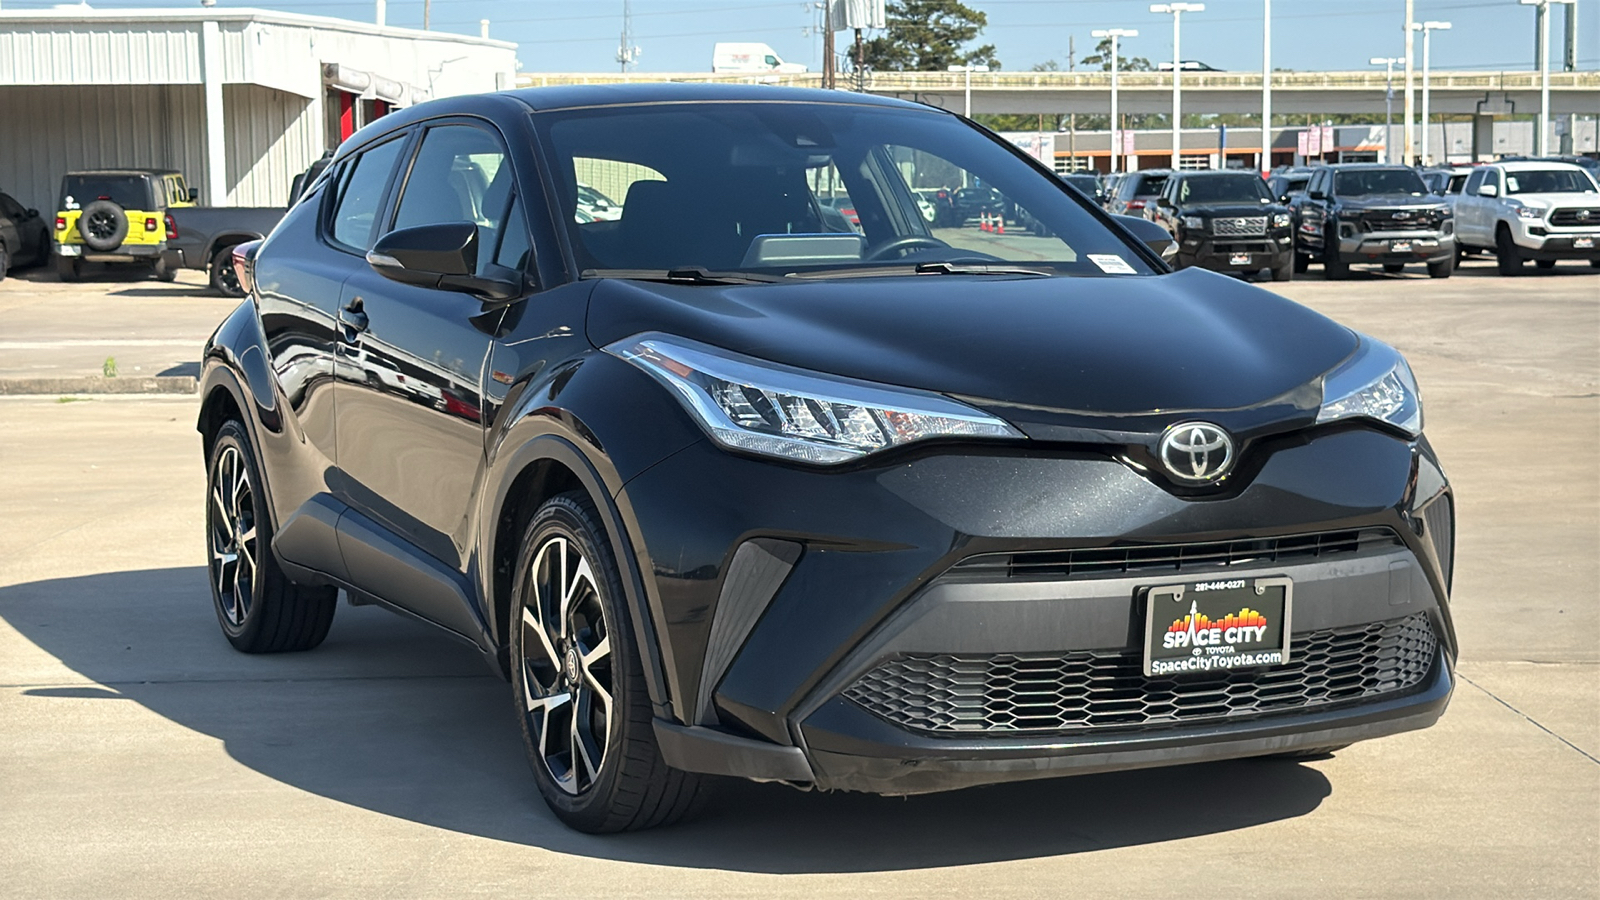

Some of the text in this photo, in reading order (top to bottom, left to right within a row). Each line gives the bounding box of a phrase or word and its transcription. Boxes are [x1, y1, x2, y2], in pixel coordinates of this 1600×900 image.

[1195, 580, 1245, 591] 281-446-0271
[1163, 625, 1267, 649] SPACE CITY
[1205, 645, 1235, 655] TOYOTA
[1152, 652, 1282, 675] SpaceCityToyota.com
